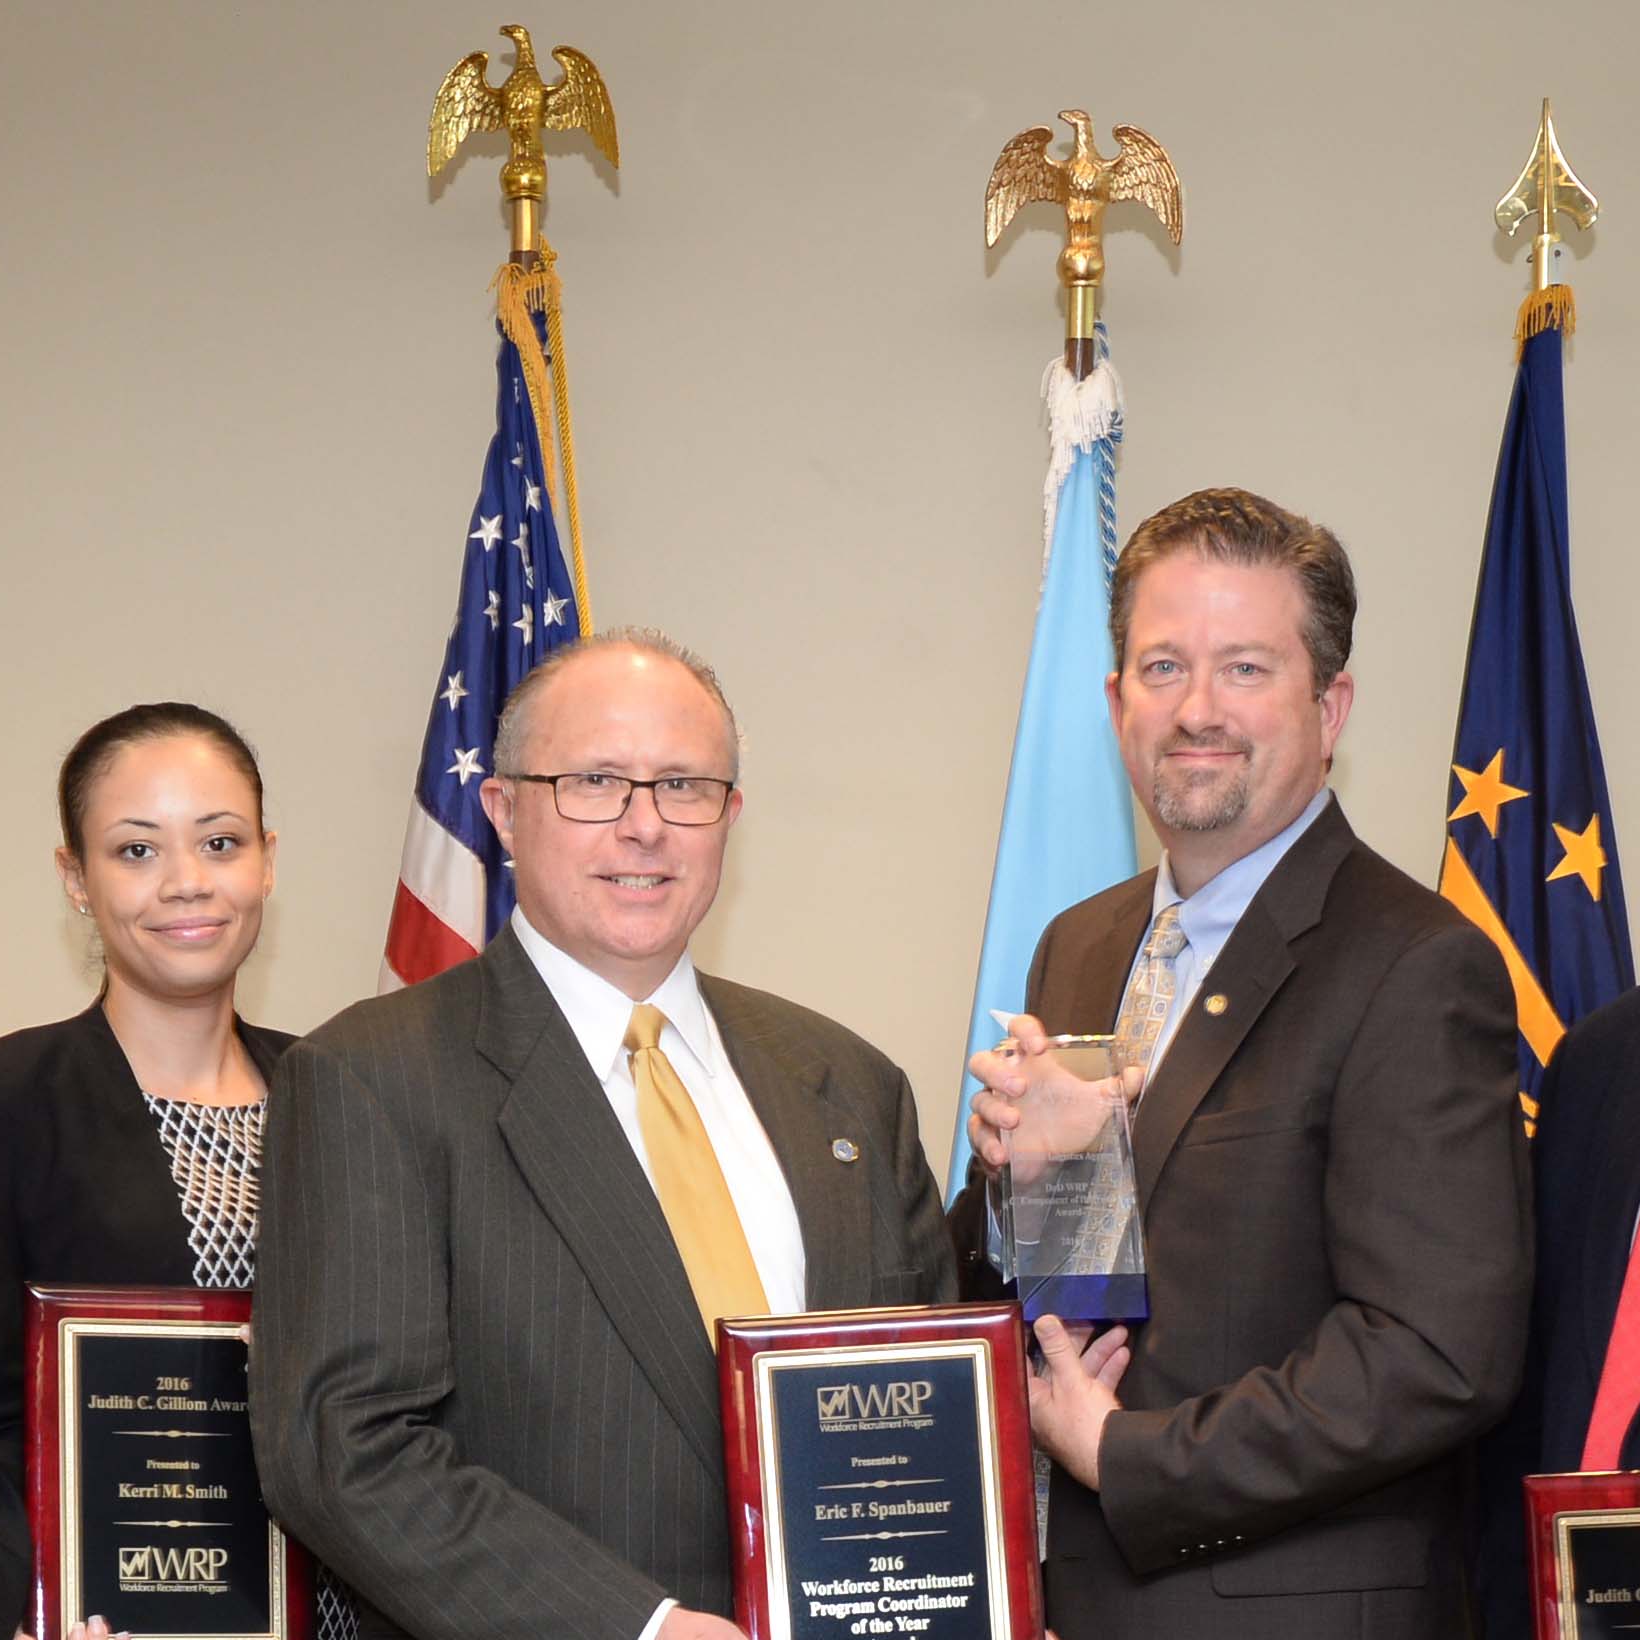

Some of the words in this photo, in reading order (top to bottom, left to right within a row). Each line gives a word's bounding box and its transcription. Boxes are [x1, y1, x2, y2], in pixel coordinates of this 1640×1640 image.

[156, 1377, 190, 1391] 2016
[88, 1395, 133, 1411] Judith
[137, 1396, 153, 1410] C.
[156, 1396, 207, 1412] Gilliom
[210, 1398, 249, 1412] Awar
[852, 1381, 933, 1418] WRP
[146, 1459, 189, 1470] Presented
[190, 1460, 200, 1470] to
[851, 1456, 896, 1467] Presented
[898, 1455, 908, 1466] to
[119, 1483, 160, 1499] Kerri
[162, 1484, 183, 1499] M.
[186, 1484, 227, 1500] Smith
[815, 1503, 847, 1521] Eric
[851, 1504, 866, 1519] F.
[869, 1499, 951, 1522] Spanbauer
[152, 1547, 228, 1580] WRP
[869, 1556, 904, 1573] 2016
[801, 1578, 880, 1598] Workforce
[883, 1572, 974, 1592] Recruitment
[1586, 1588, 1632, 1604] Judith
[810, 1601, 875, 1620] Program
[878, 1594, 968, 1614] Coordinator
[851, 1619, 867, 1635] of
[870, 1618, 894, 1634] the
[897, 1616, 930, 1632] Year
